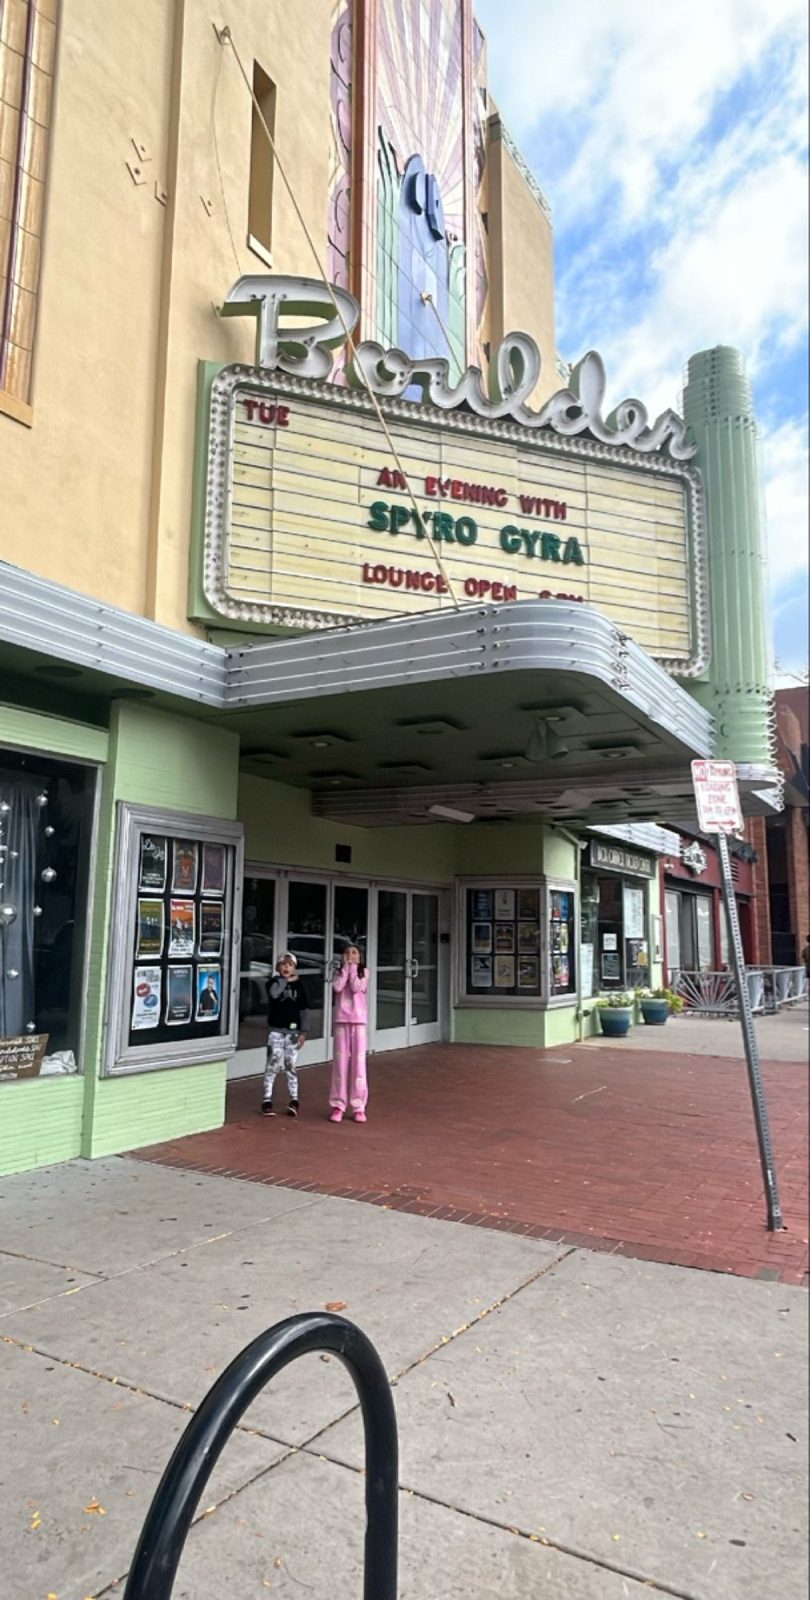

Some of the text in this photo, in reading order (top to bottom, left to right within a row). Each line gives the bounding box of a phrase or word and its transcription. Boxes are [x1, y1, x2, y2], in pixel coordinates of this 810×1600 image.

[220, 275, 697, 461] Boulder
[243, 399, 290, 427] TUE
[376, 466, 567, 520] AN EVENING WITH
[367, 500, 585, 566] SPYRO GYRA
[362, 562, 449, 593] LOUNGE
[464, 577, 518, 602] OPEN
[708, 794, 728, 804] ZONE
